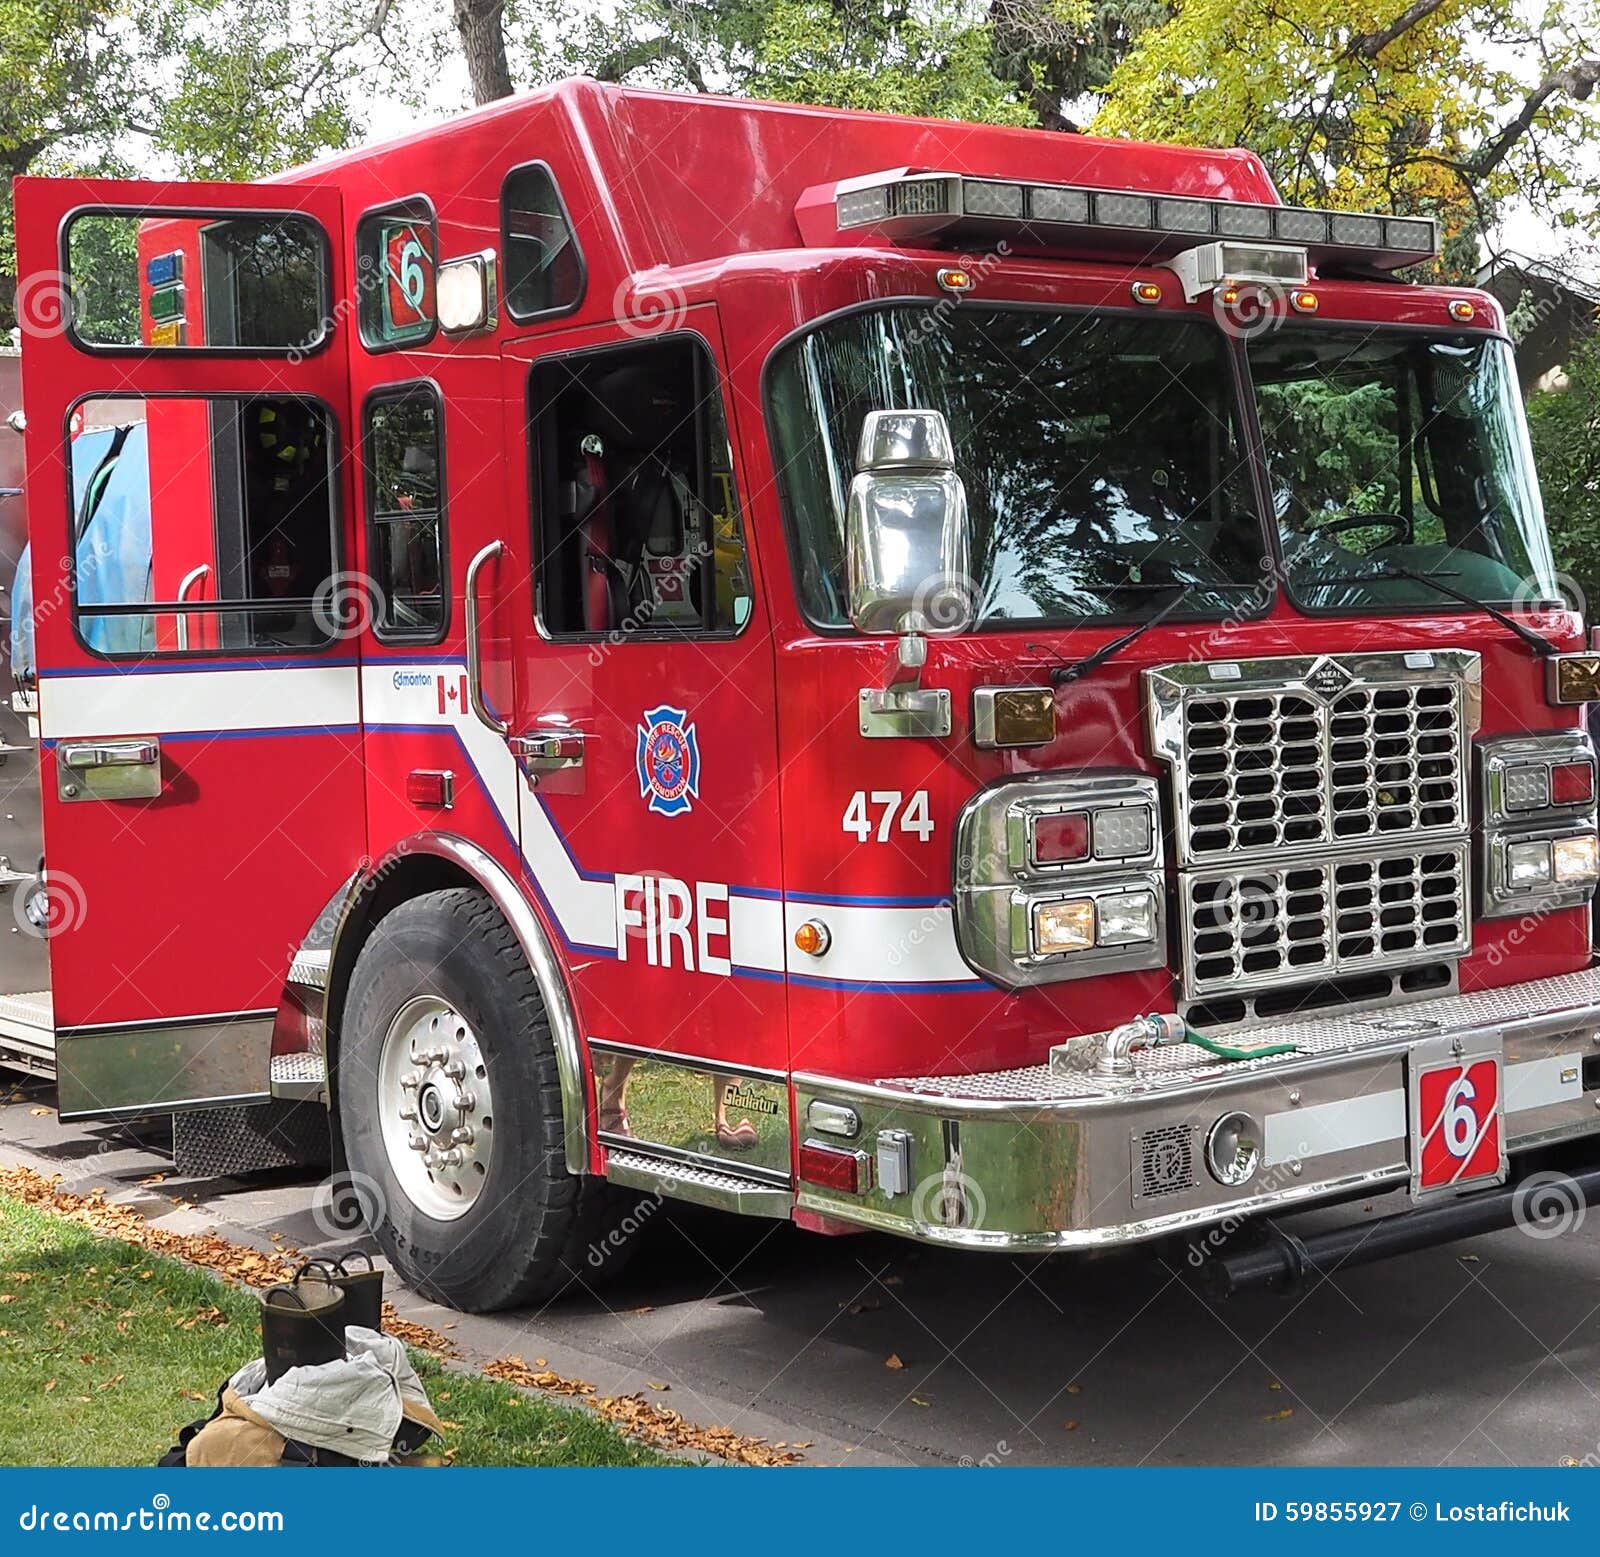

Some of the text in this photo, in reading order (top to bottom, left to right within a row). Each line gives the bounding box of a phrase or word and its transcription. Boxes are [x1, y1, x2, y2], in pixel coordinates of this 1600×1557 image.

[400, 241, 424, 308] 6
[393, 671, 431, 690] Edmonton
[647, 725, 687, 752] FIRE RESCUE
[651, 776, 687, 798] EDMONTON
[843, 791, 934, 842] 474
[615, 873, 731, 976] FIRE
[1444, 1078, 1476, 1158] 6
